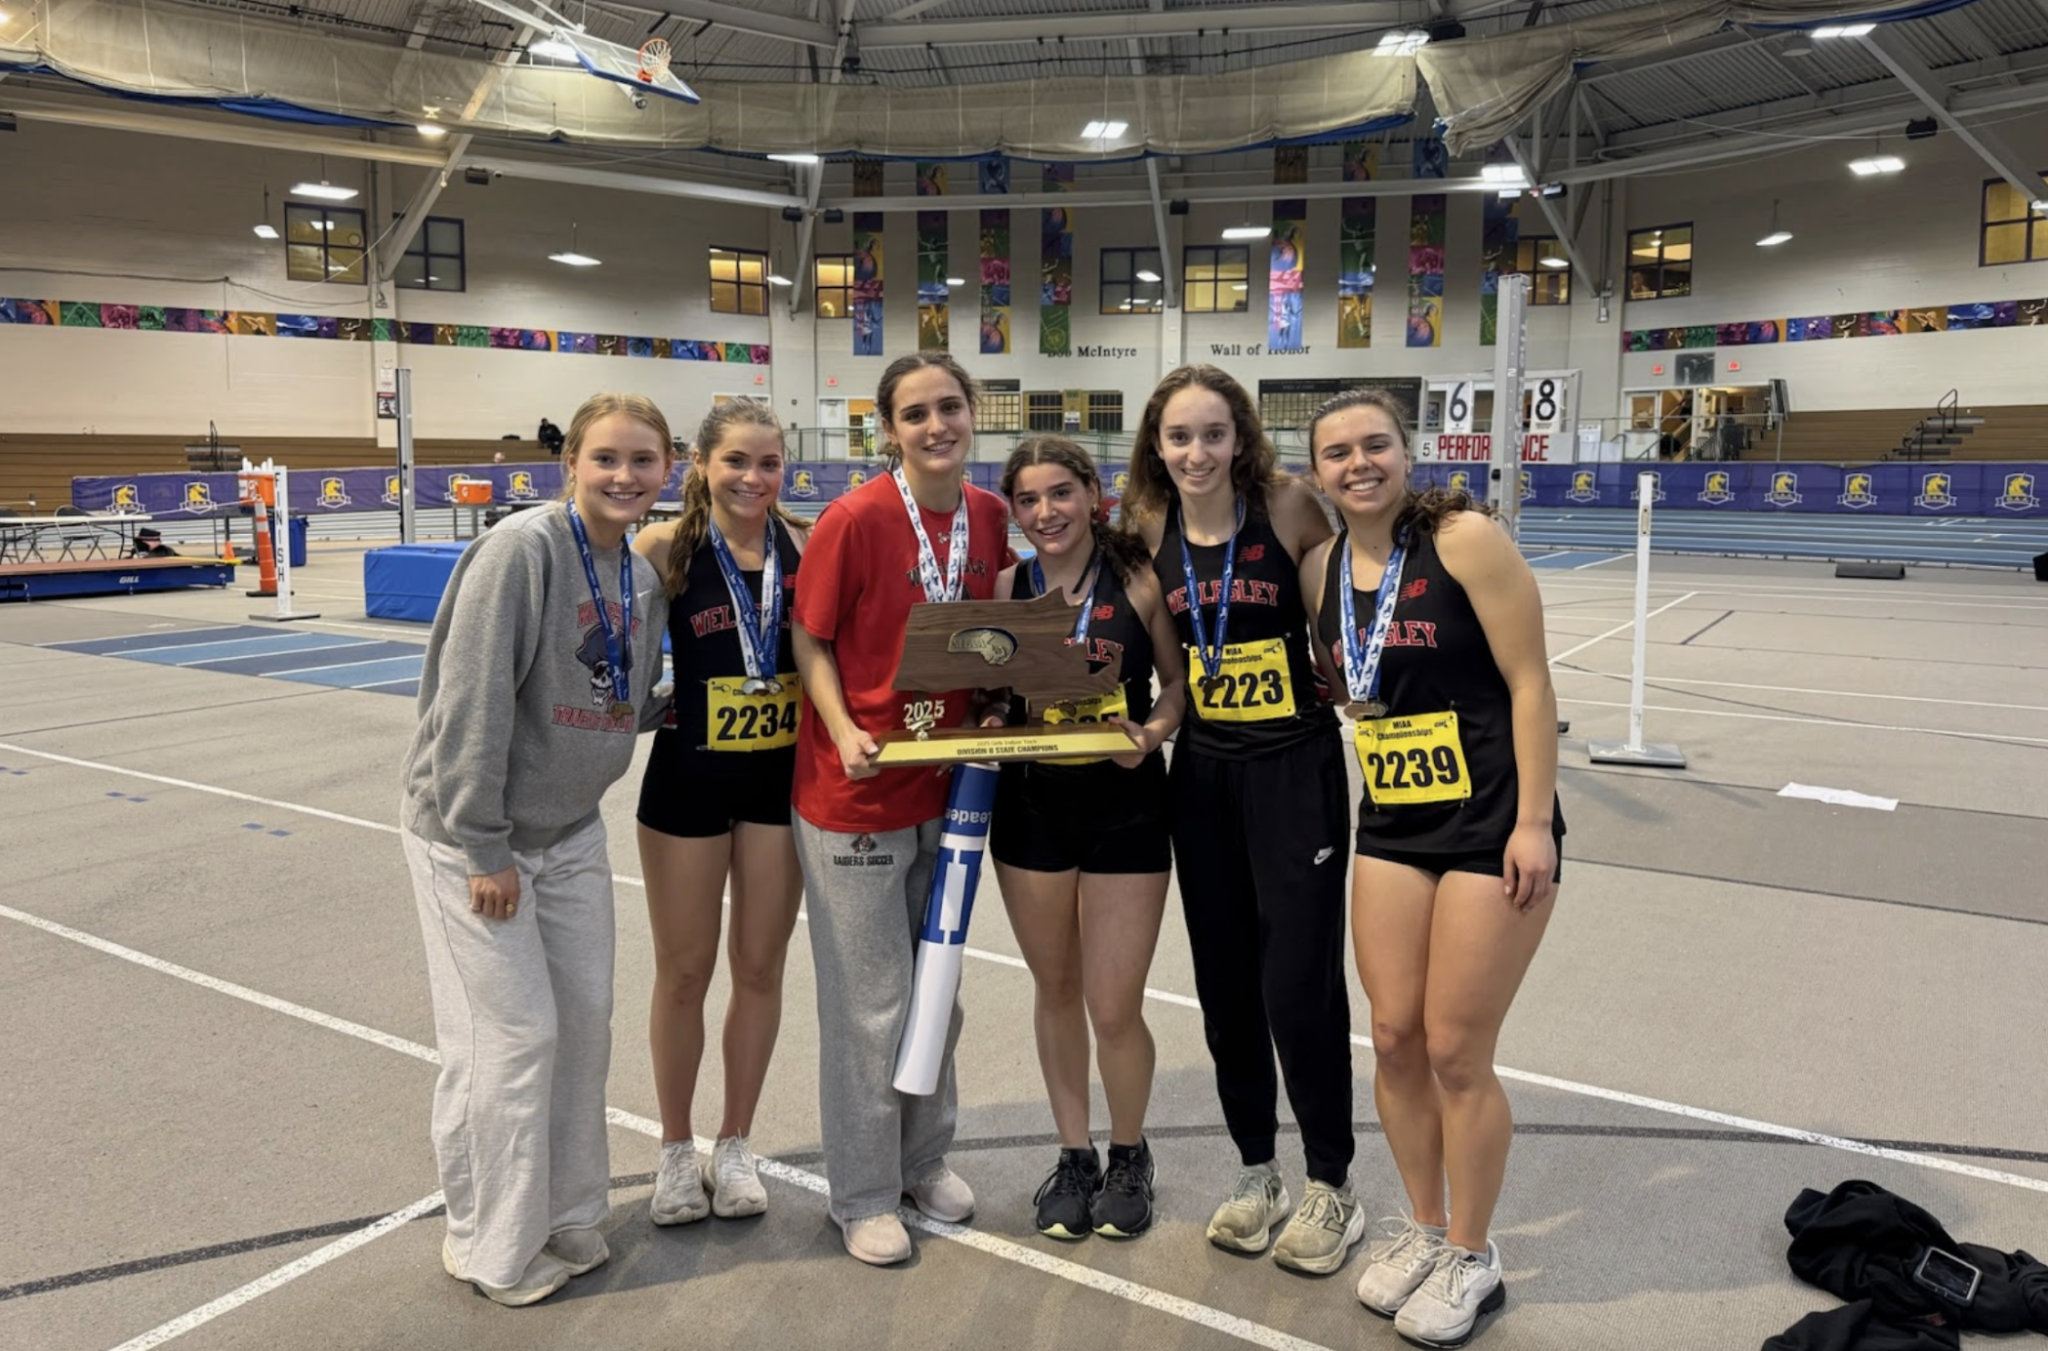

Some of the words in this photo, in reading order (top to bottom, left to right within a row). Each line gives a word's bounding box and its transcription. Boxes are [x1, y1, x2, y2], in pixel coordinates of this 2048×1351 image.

[1077, 345, 1137, 359] McIntyre
[1210, 344, 1241, 356] Wall
[1246, 343, 1262, 356] of
[1449, 381, 1468, 422] 6
[1535, 379, 1556, 421] 8
[1422, 442, 1431, 457] 5
[1437, 435, 1550, 461] PERFORNCE
[275, 472, 285, 582] FINISH
[119, 576, 139, 584] GILL
[1166, 579, 1278, 615] WELESLEY
[1197, 669, 1284, 709] 2223
[716, 701, 797, 740] 2234
[903, 700, 945, 722] 2025
[1376, 729, 1433, 742] Championships
[1392, 720, 1413, 730] MIAA
[957, 748, 988, 756] DIVISION
[995, 746, 1016, 754] STATE
[1017, 744, 1059, 753] CHAMPIONS
[1367, 745, 1461, 790] 2239
[866, 855, 895, 866] SOCCER
